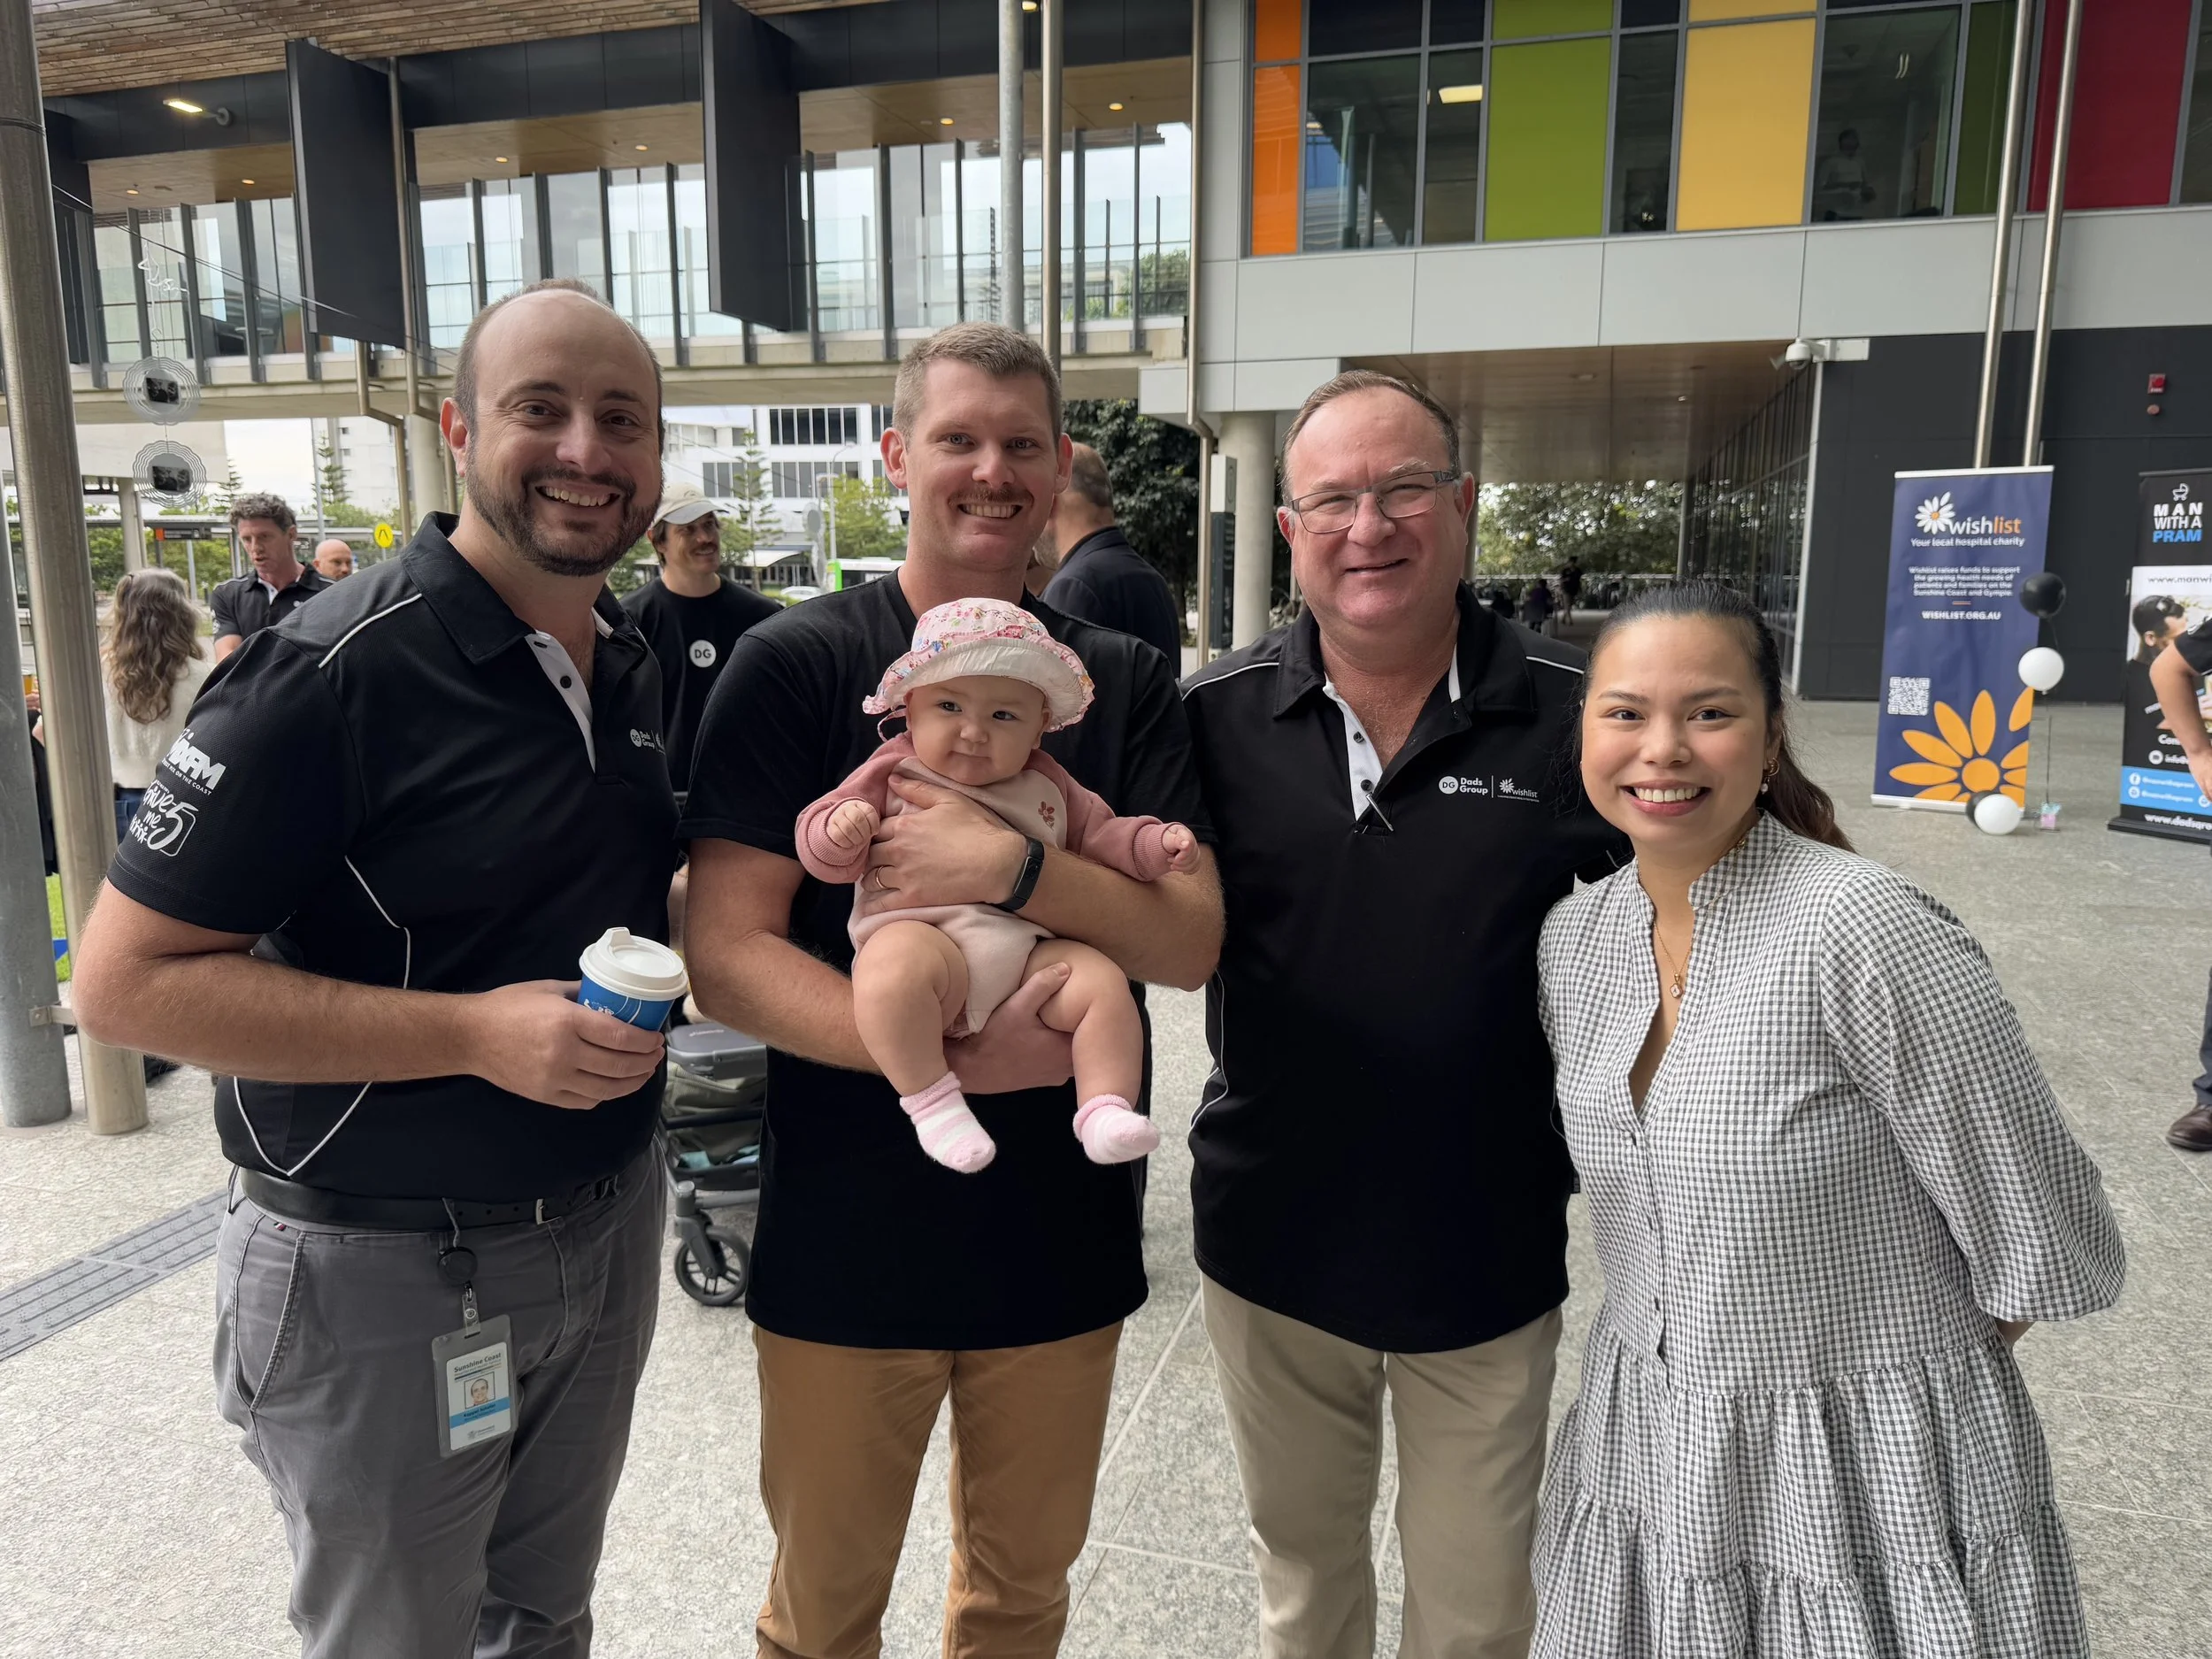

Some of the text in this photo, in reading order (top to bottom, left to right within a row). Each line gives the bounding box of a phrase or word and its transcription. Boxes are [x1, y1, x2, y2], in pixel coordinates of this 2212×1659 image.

[2153, 502, 2203, 517] MAN
[1948, 515, 2022, 534] wishlist
[2154, 515, 2202, 530] WITH A
[1910, 536, 2024, 548] Your local hospital charity
[2153, 529, 2202, 542] PRAM
[1922, 611, 2001, 620] WISHLIST.ORG.AU
[695, 649, 711, 658] DG
[181, 774, 193, 785] THE
[192, 782, 212, 796] COAST
[1460, 777, 1483, 787] Dads
[1459, 785, 1488, 795] Group
[1511, 788, 1538, 798] wishlist
[143, 810, 161, 829] me
[146, 801, 199, 850] 5
[454, 1358, 483, 1373] Sunshine
[484, 1352, 502, 1363] Coast
